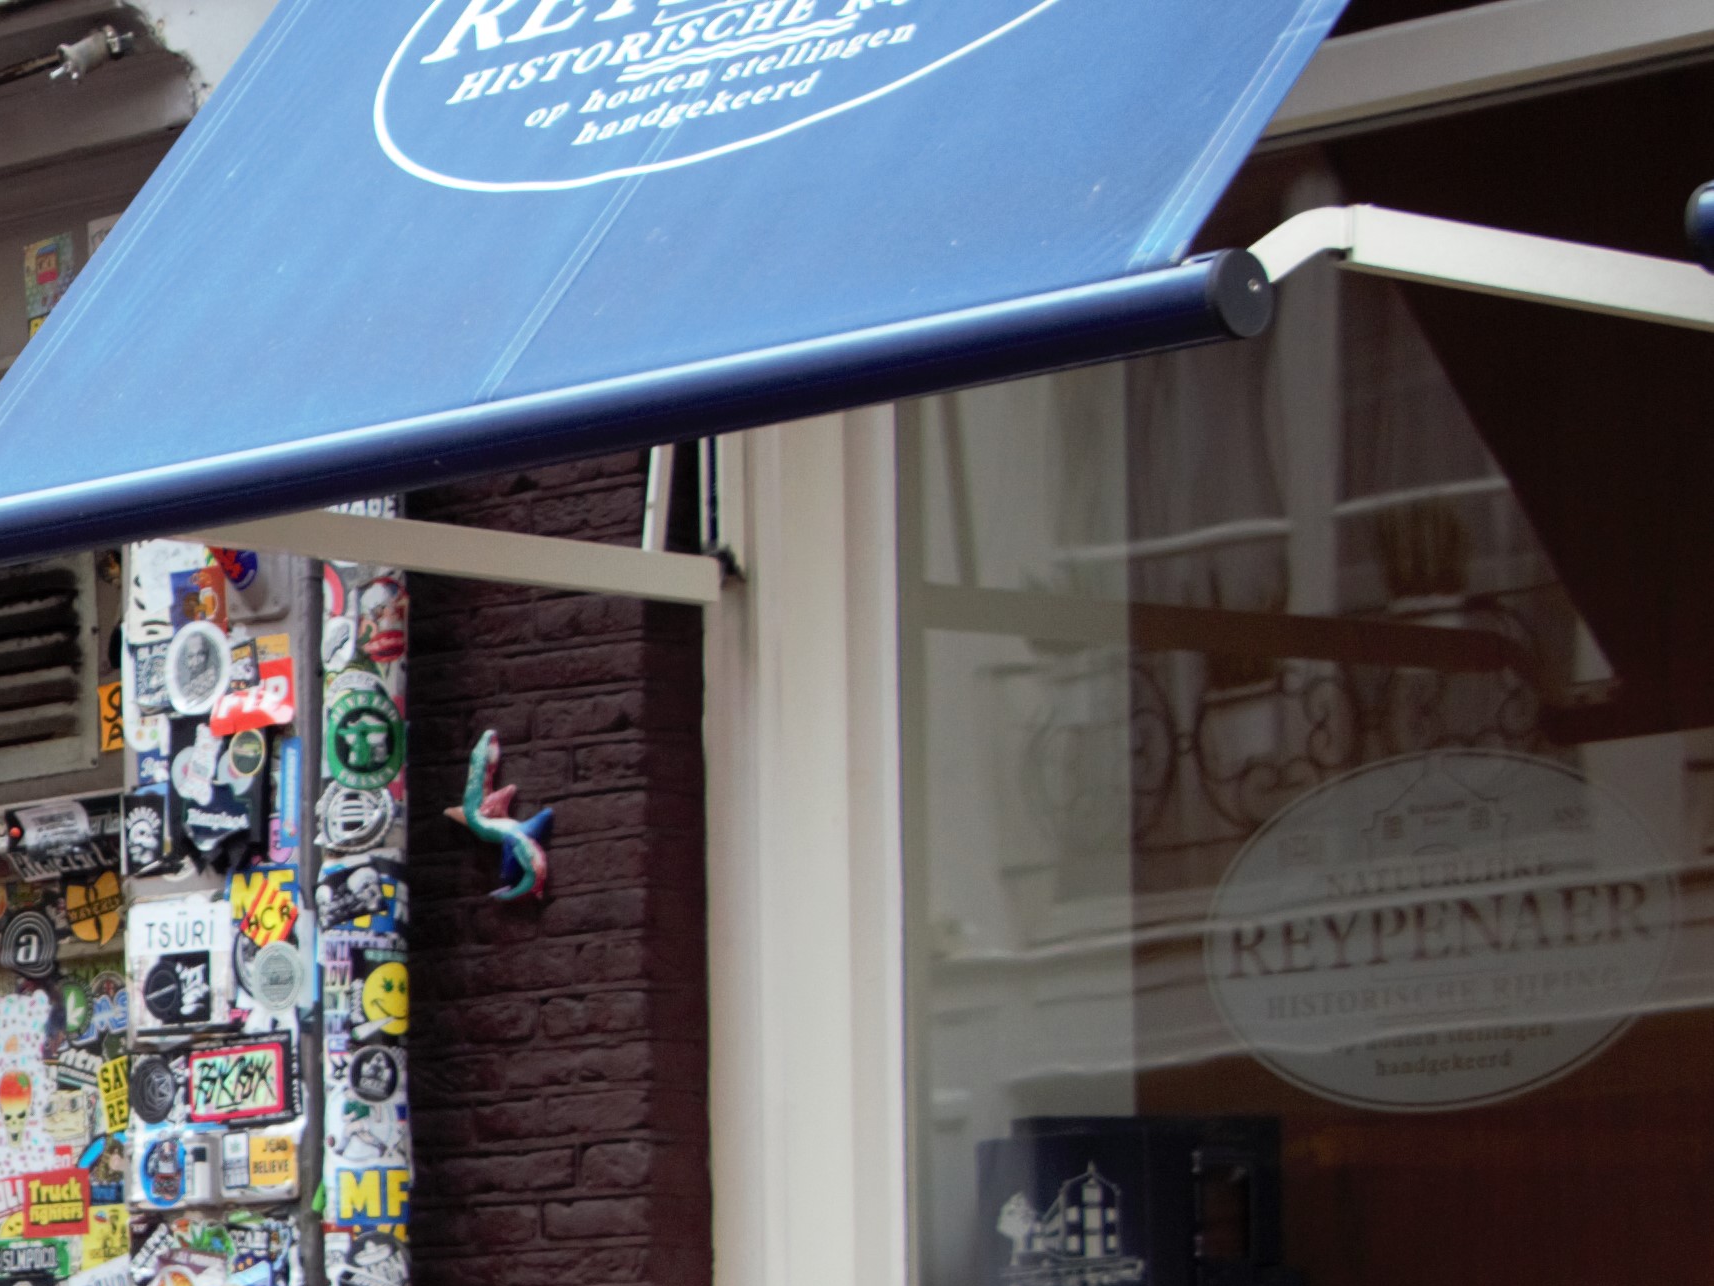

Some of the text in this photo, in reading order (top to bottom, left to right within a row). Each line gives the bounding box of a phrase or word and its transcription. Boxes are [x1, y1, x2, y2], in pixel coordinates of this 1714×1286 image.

[524, 100, 571, 128] op
[578, 70, 711, 114] houten
[720, 23, 917, 82] stellingen
[570, 71, 823, 146] handgekeerd
[1226, 880, 1659, 981] REYPENAER
[28, 1178, 84, 1202] Truck
[338, 1169, 410, 1219] MF
